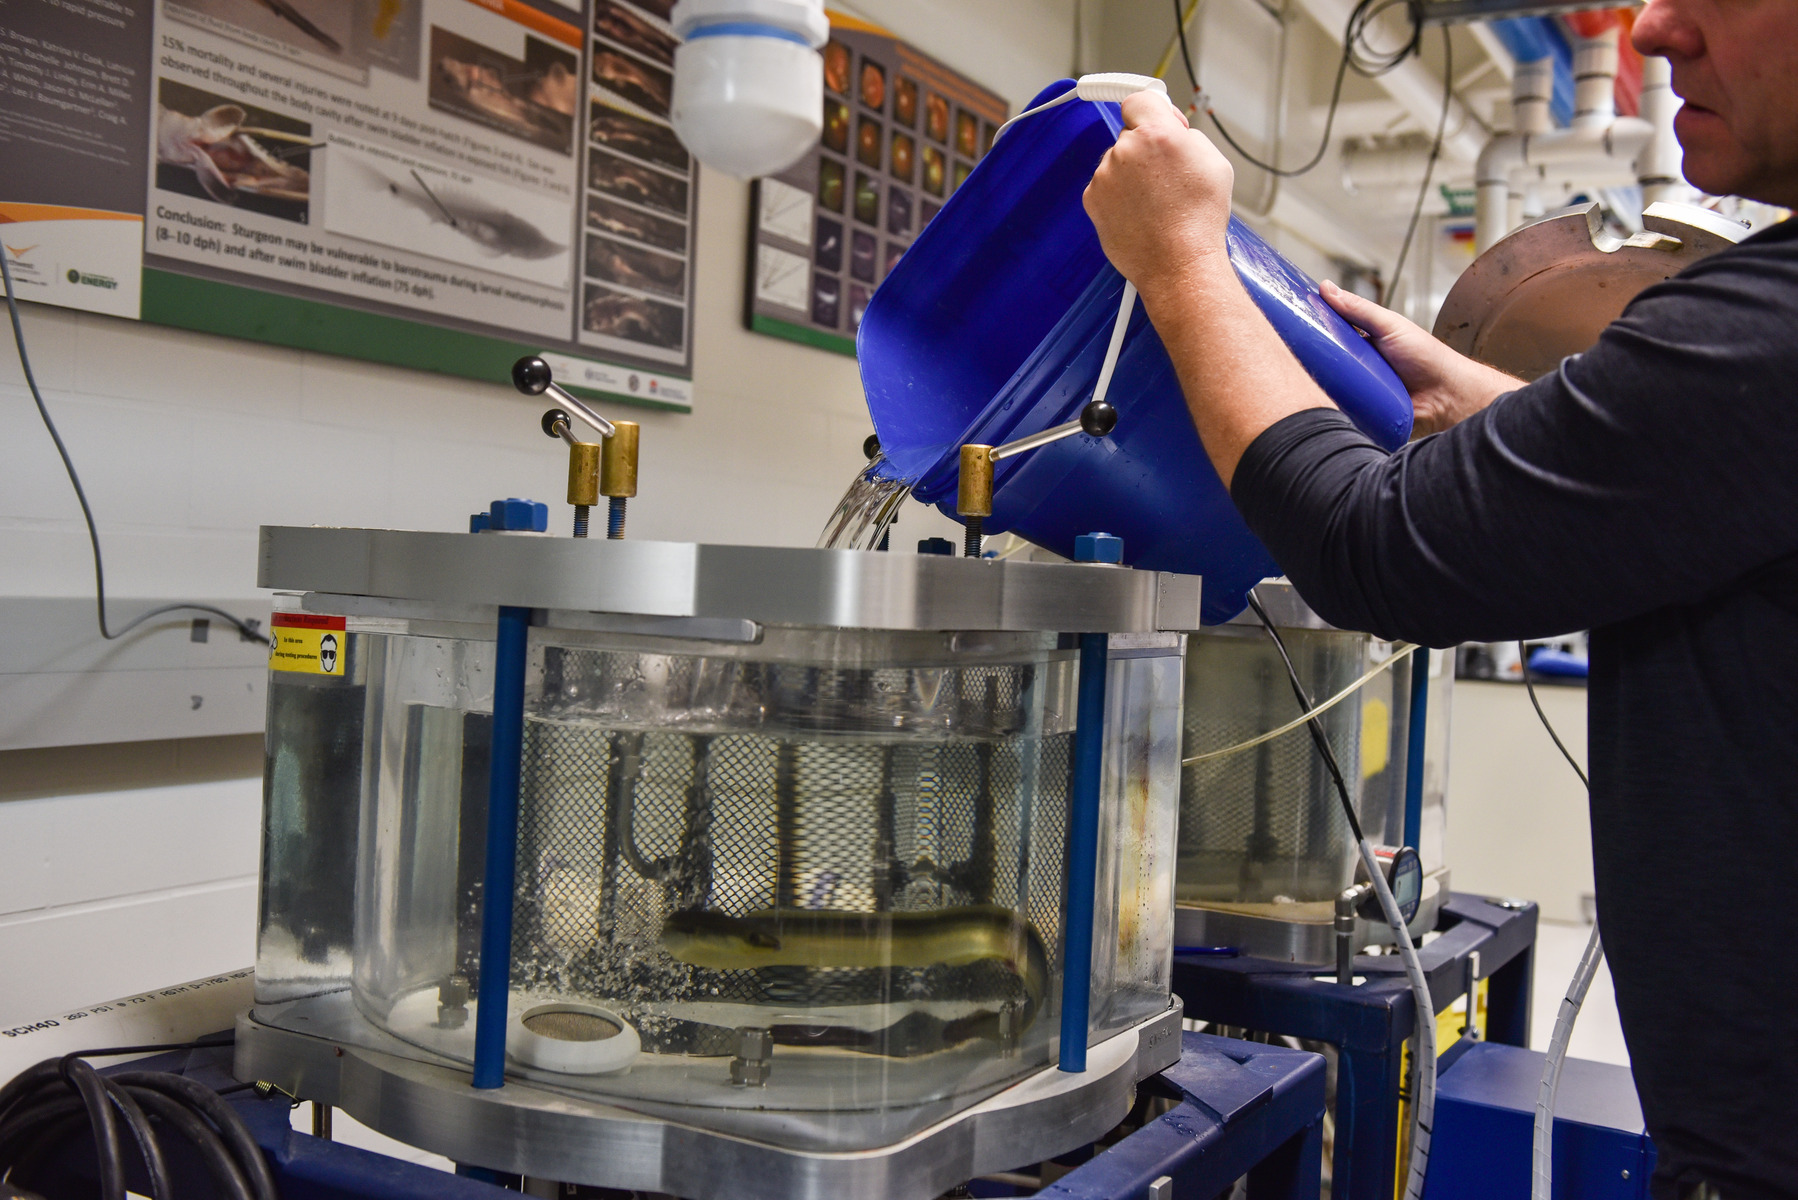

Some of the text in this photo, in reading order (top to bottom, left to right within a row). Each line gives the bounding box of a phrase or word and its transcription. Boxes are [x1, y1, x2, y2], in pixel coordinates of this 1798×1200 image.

[87, 9, 127, 29] pressure
[160, 54, 210, 80] observed
[212, 70, 270, 95] throughout
[271, 89, 289, 104] the
[289, 96, 313, 113] body
[315, 104, 342, 122] cavity
[344, 113, 364, 128] after
[162, 34, 185, 52] 15%
[187, 45, 234, 71] mortality
[237, 62, 256, 76] and
[258, 69, 292, 87] several
[295, 80, 328, 99] injuries
[330, 93, 352, 107] were
[354, 101, 380, 117] noted
[156, 205, 227, 233] Conclusion:
[231, 222, 282, 245] Sturgeon
[285, 237, 308, 254] may
[310, 241, 324, 256] be
[326, 246, 379, 268] vulnerable
[380, 259, 392, 271] to
[393, 261, 448, 284] barotrauma
[449, 275, 478, 294] during
[193, 235, 221, 255] dph)
[223, 242, 246, 258] and
[248, 247, 276, 264] after
[278, 256, 307, 272] swim
[308, 260, 349, 280] bladder
[350, 270, 392, 290] inflation
[81, 276, 118, 290] ENERGY
[2, 1019, 60, 1038] SCH40
[90, 1005, 113, 1014] PSI
[160, 986, 190, 998] ASTM
